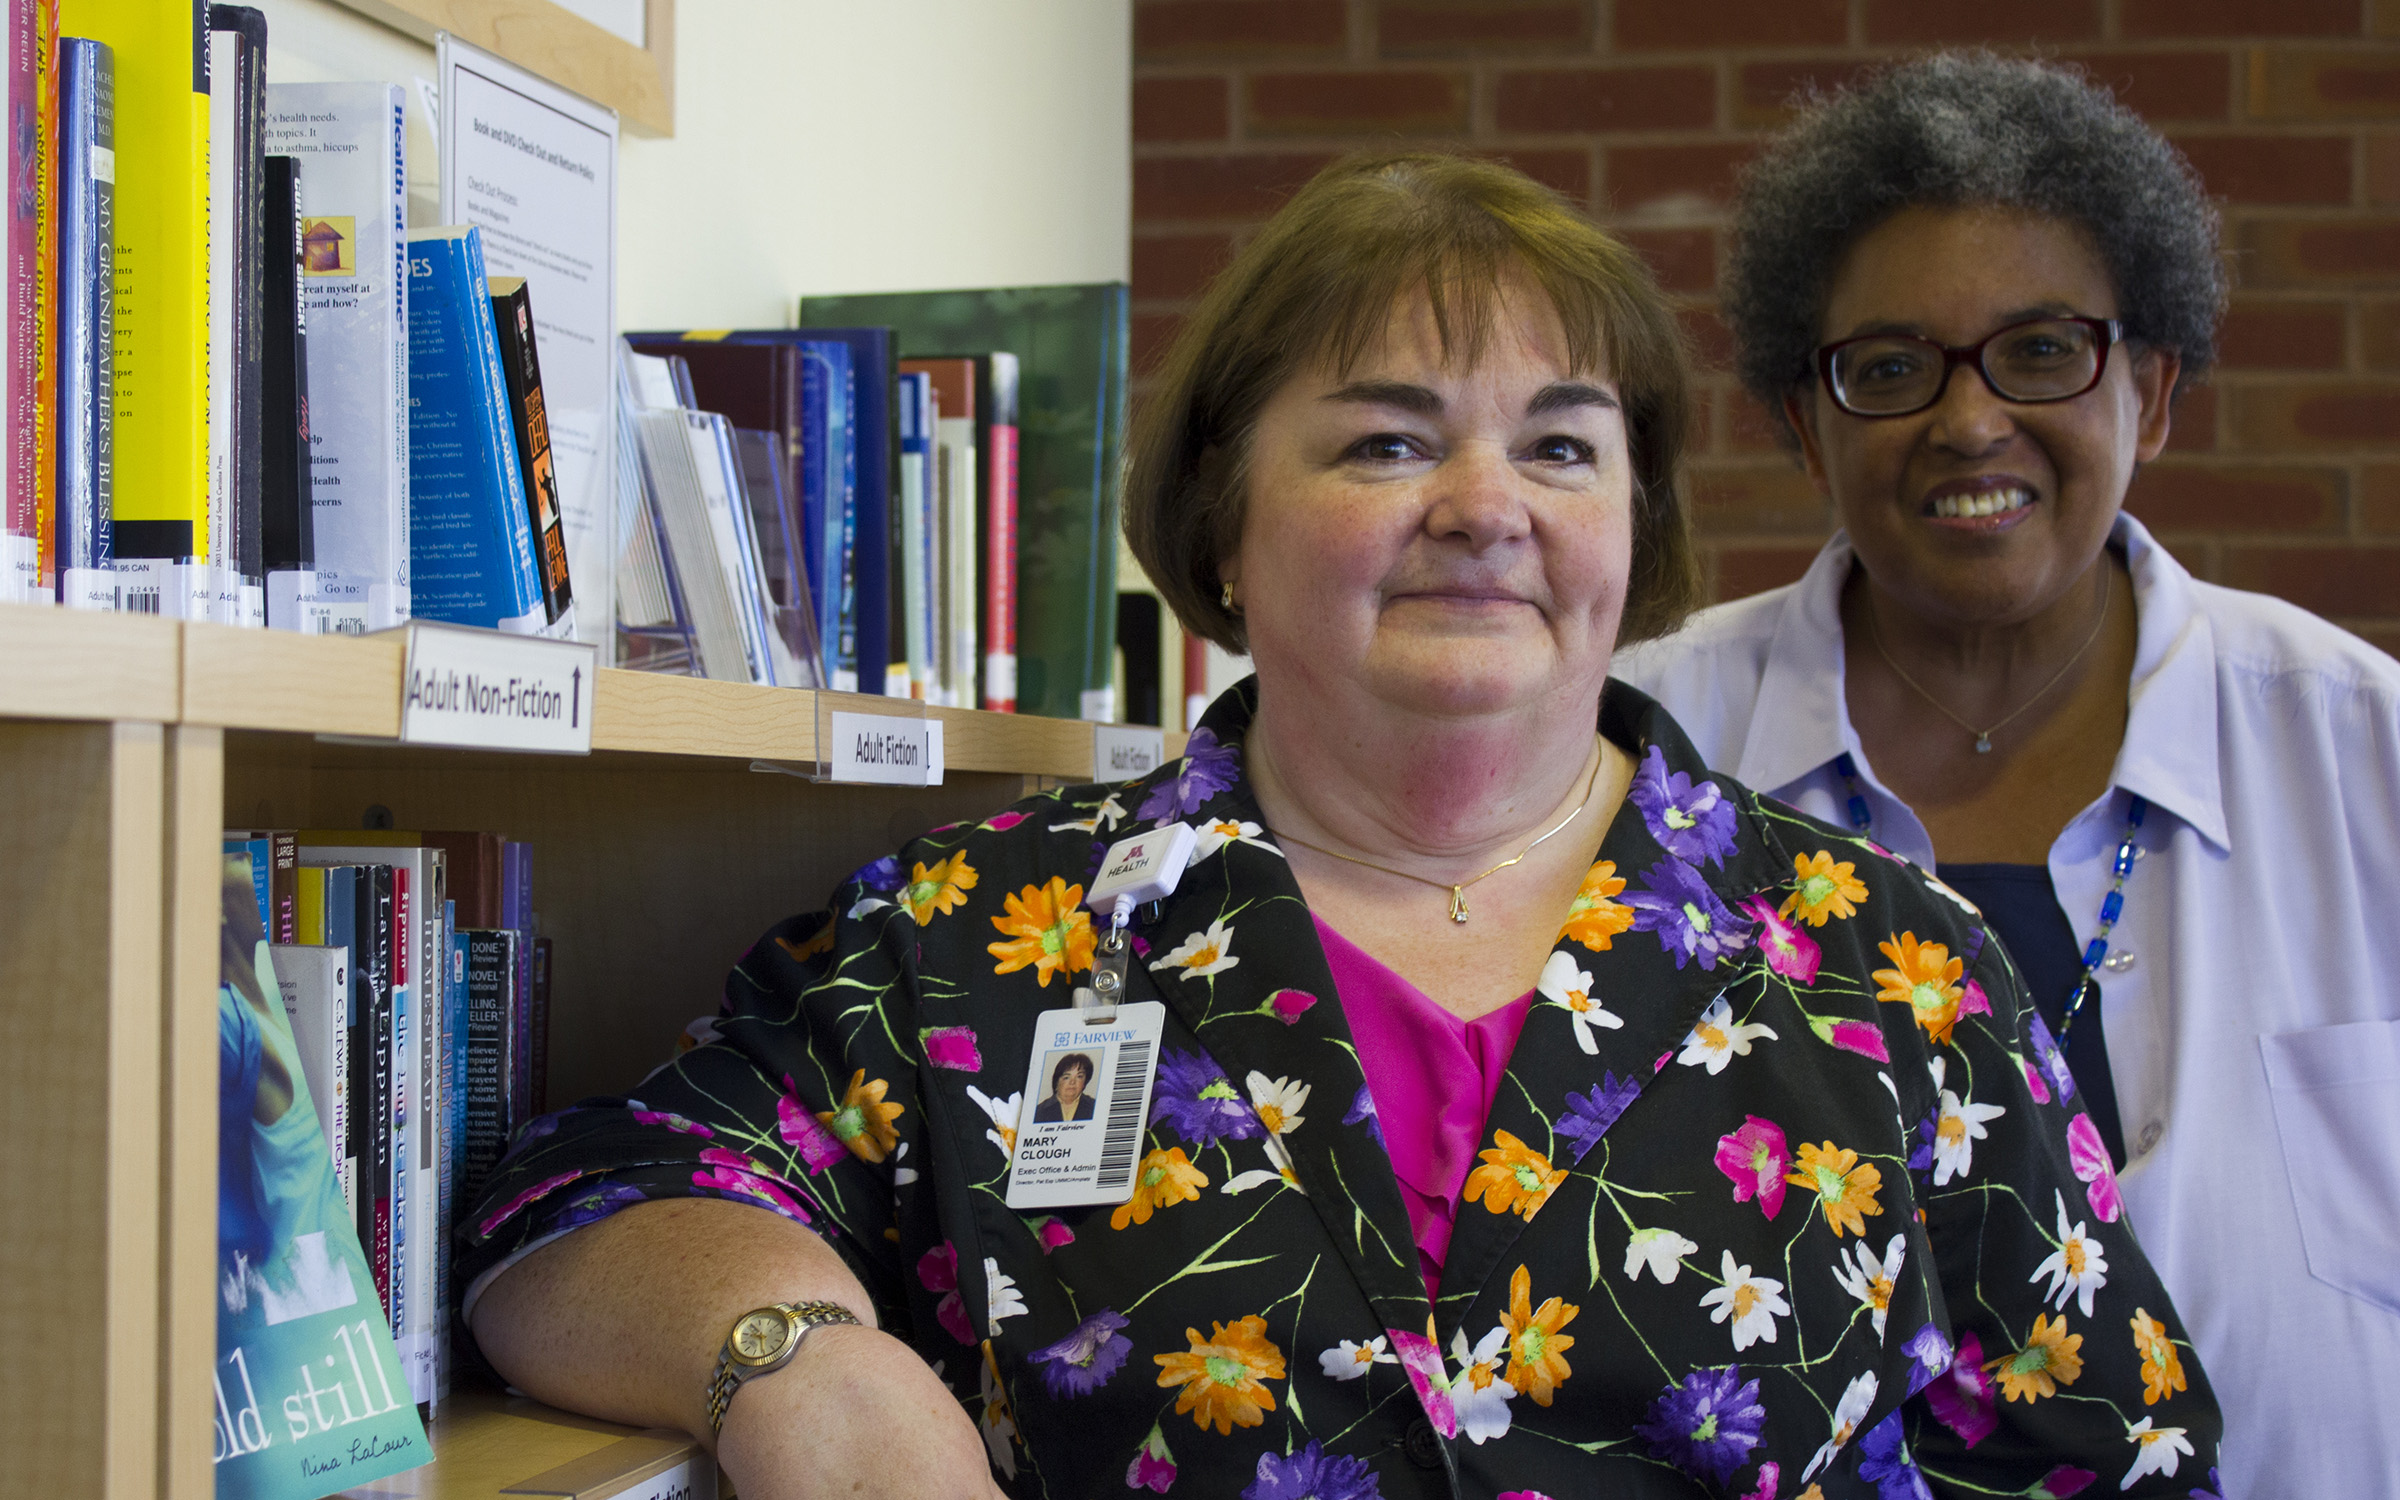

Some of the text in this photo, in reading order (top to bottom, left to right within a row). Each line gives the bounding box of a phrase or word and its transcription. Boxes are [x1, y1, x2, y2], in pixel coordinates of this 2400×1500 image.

[20, 30, 28, 72] RELIN
[279, 112, 339, 123] health needs.
[277, 128, 317, 140] topics. It
[474, 117, 490, 135] Book
[490, 127, 503, 143] and
[503, 130, 517, 148] DVD
[518, 137, 535, 155] Check
[536, 144, 547, 160] Out
[274, 145, 283, 153] to
[286, 144, 321, 153] asthma,
[323, 142, 359, 154] hiccups
[100, 193, 111, 236] MY
[394, 104, 405, 323] Health at Home
[117, 244, 133, 254] the
[18, 254, 26, 277] and
[326, 283, 359, 296] myself
[361, 284, 371, 294] at
[18, 283, 26, 316] Build
[312, 298, 359, 309] and how?
[117, 305, 133, 315] the
[18, 321, 26, 369] Nations
[99, 243, 111, 454] GRANDFATHER'S
[123, 389, 133, 397] to
[18, 395, 26, 423] One
[27, 400, 32, 412] to
[120, 410, 133, 418] on
[25, 418, 33, 448] Fight
[18, 428, 26, 469] School
[36, 403, 44, 499] Michael
[18, 473, 24, 484] at
[500, 428, 518, 511] AMERICA
[18, 500, 26, 533] Time
[216, 514, 223, 522] of
[132, 563, 150, 572] CAN
[317, 569, 338, 581] pics
[325, 583, 360, 594] Go to:
[408, 668, 563, 720] Adult Non-Fiction
[855, 731, 918, 767] Adult Fiction
[276, 844, 294, 858] LARGE
[277, 857, 293, 870] PRINT
[1106, 857, 1150, 878] HEALTH
[472, 955, 499, 963] Review
[424, 920, 432, 1112] HOMESTEAD
[376, 893, 391, 1167] Laura Lippman
[398, 1014, 408, 1057] the
[472, 1023, 498, 1032] Review
[1073, 1029, 1137, 1045] FAIRVIEW
[335, 1030, 344, 1078] LEWIS
[488, 1066, 498, 1074] of
[474, 1086, 497, 1094] some
[335, 1102, 343, 1132] THE
[1056, 1123, 1086, 1132] Fairview
[1022, 1136, 1058, 1148] MARY
[335, 1135, 343, 1175] LION
[1020, 1148, 1072, 1161] CLOUGH
[1017, 1163, 1097, 1176] Exec Office & Admin
[397, 1169, 407, 1231] Lake
[283, 1319, 402, 1446] still
[300, 1435, 413, 1478] Nina LaCour
